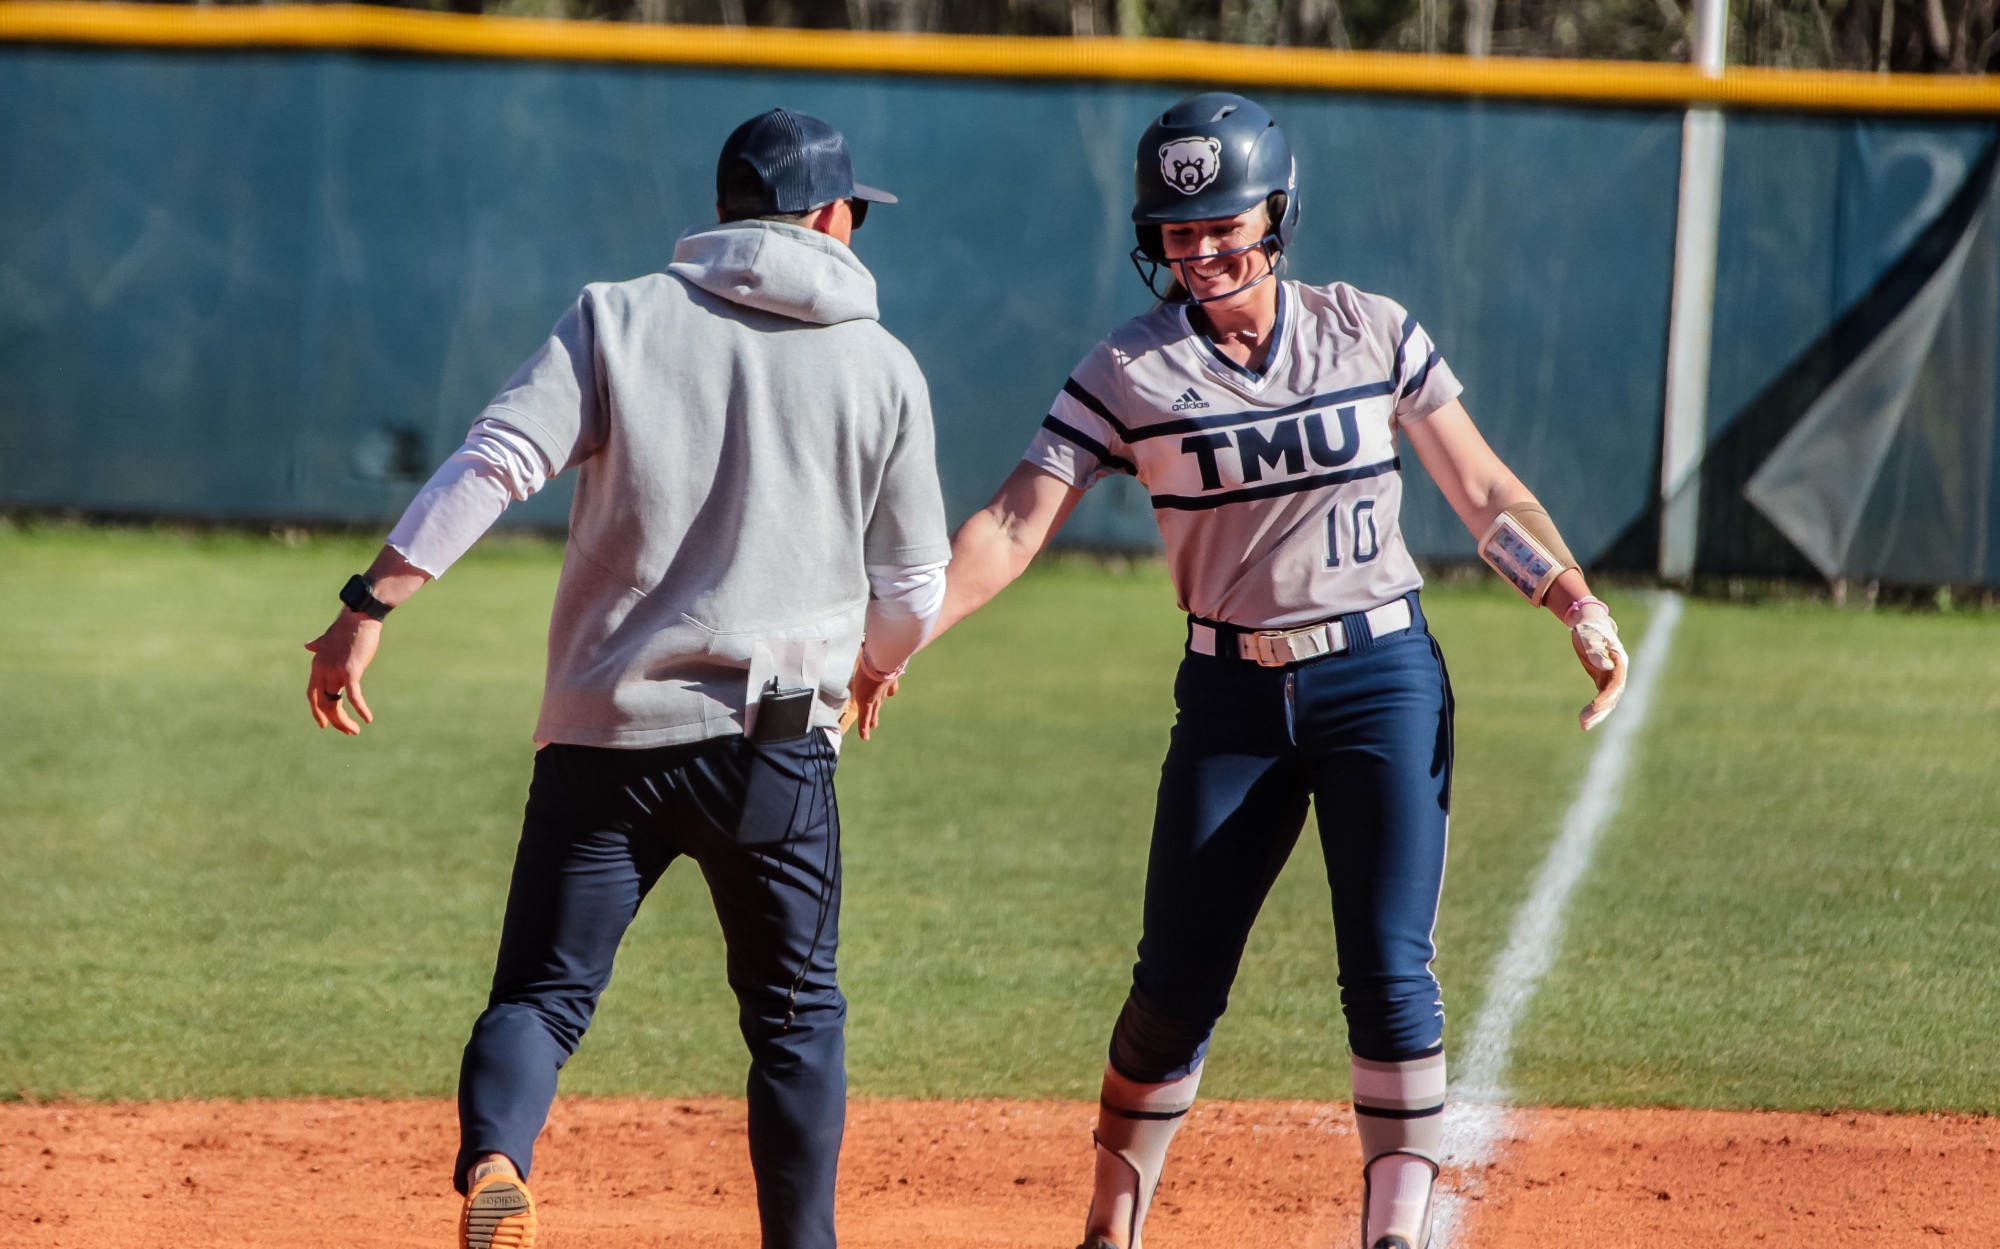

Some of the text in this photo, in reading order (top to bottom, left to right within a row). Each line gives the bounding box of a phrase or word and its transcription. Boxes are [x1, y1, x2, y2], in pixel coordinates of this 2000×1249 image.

[1171, 401, 1210, 411] adidas
[1181, 405, 1360, 491] TMU
[1323, 497, 1380, 571] 10
